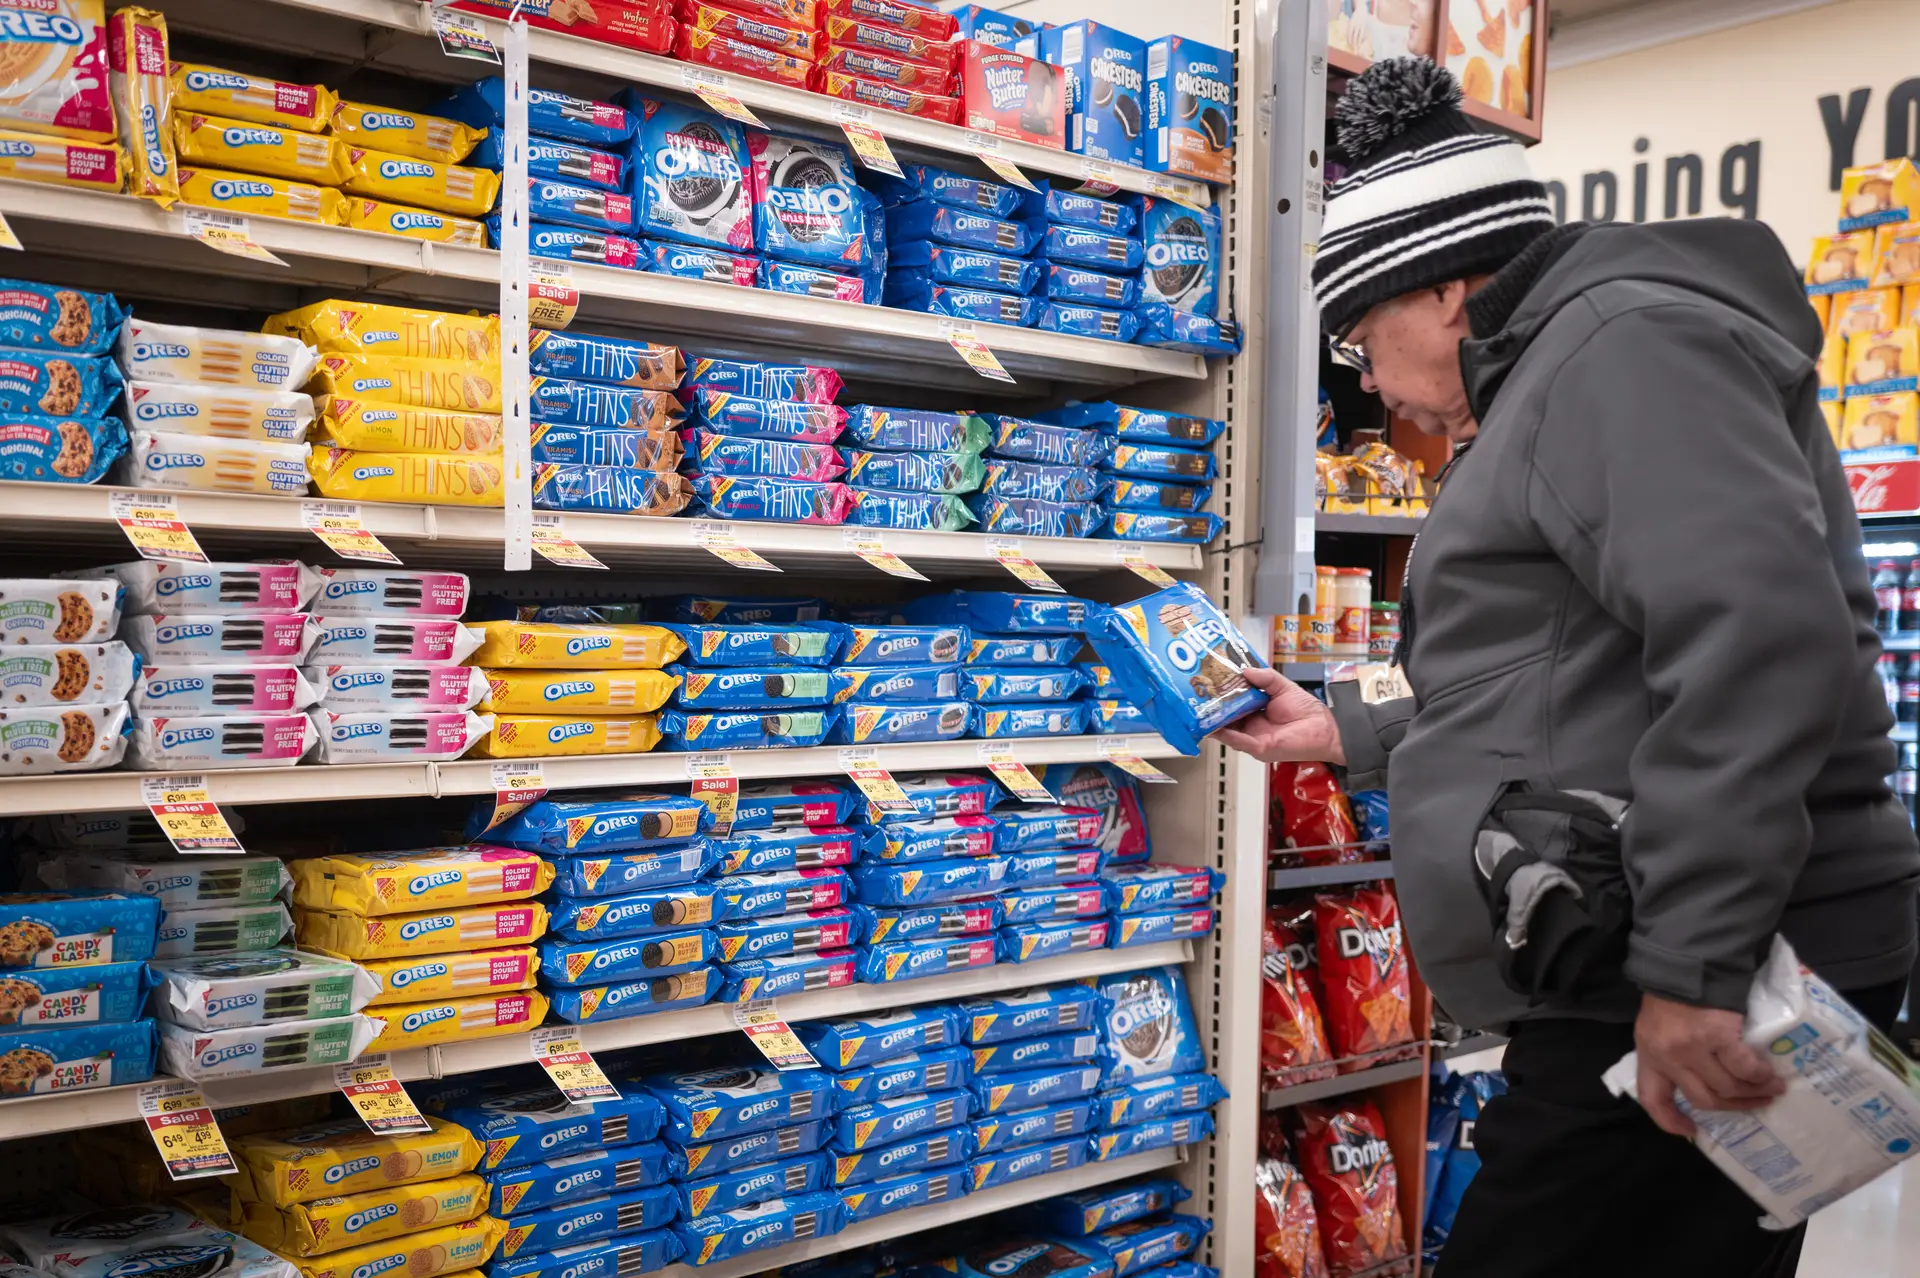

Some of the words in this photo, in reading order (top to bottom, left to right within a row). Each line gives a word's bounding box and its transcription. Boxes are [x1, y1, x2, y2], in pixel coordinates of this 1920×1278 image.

[0, 10, 82, 42] REO
[623, 10, 649, 25] Wafers
[735, 18, 760, 34] Nutter
[761, 24, 787, 41] Butter
[856, 24, 881, 40] Nutter
[882, 30, 910, 48] Butter
[844, 51, 869, 67] Nutter
[870, 57, 900, 76] Butter
[981, 54, 998, 64] FUDGE
[999, 54, 1024, 64] COVERED
[1090, 58, 1142, 93] CAKESTERS
[1188, 62, 1219, 75] OREO
[186, 71, 248, 91] OREO
[985, 67, 1024, 89] Nutter
[277, 86, 309, 98] GOLDEN
[855, 79, 880, 96] Nutter
[881, 86, 910, 104] Butter
[990, 83, 1028, 106] Butter
[1175, 73, 1230, 105] CAKESTERS
[277, 94, 309, 105] DOUBLE
[277, 101, 298, 110] STUF
[361, 111, 415, 131] OREO
[142, 104, 166, 177] OREO
[666, 132, 704, 151] DOUBLE
[705, 140, 729, 156] STUF
[70, 151, 106, 162] GOLDEN
[70, 160, 105, 170] DOUBLE
[70, 167, 92, 176] STUF
[380, 161, 434, 180] OREO
[211, 181, 274, 201] OREO
[390, 213, 443, 231] OREO
[535, 232, 584, 248] OREO
[1147, 243, 1209, 267] OREO
[538, 286, 569, 300] Sale!
[0, 309, 42, 326] ORIGINAL
[532, 307, 565, 320] FREE
[362, 332, 399, 345] OREO
[400, 321, 464, 361] THINS
[133, 344, 190, 363] OREO
[256, 352, 288, 363] GOLDEN
[545, 352, 577, 362] TIRAMISU
[581, 340, 636, 381] THINS
[252, 364, 289, 377] GLUTEN
[257, 373, 284, 384] FREE
[740, 365, 794, 401] THINS
[137, 403, 198, 420] OREO
[366, 426, 392, 434] LEMON
[545, 433, 577, 443] OREO
[909, 420, 952, 453] THINS
[1, 444, 44, 458] ORIGINAL
[545, 446, 577, 454] TIRAMISU
[579, 428, 636, 469] THINS
[1034, 431, 1072, 463] THINS
[146, 453, 205, 471] OREO
[271, 460, 304, 471] GOLDEN
[353, 466, 394, 480] OREO
[397, 456, 466, 496] THINS
[760, 485, 813, 519] THINS
[156, 575, 212, 597] OREO
[326, 581, 377, 599] OREO
[431, 590, 463, 599] GLUTEN
[276, 591, 293, 600] FREE
[28, 606, 50, 616] FREE!
[5, 618, 44, 630] ORIGINAL
[876, 636, 920, 656] OREO
[1165, 618, 1235, 673] OREO
[146, 678, 204, 700] OREO
[265, 685, 295, 693] GLUTEN
[332, 672, 384, 691] OREO
[718, 673, 762, 691] OREO
[492, 681, 509, 700] FAMILY
[544, 681, 595, 701] OREO
[3, 727, 31, 738] GLUTEN
[31, 726, 55, 737] FREE!
[162, 727, 214, 750] OREO
[442, 736, 460, 744] FREE
[500, 726, 518, 743] FAMILY
[506, 733, 519, 745] SIZE
[10, 738, 49, 749] ORIGINAL
[277, 741, 298, 749] FREE
[701, 780, 729, 790] Sale!
[507, 791, 538, 802] Sale!
[164, 804, 205, 814] Sale!
[806, 808, 829, 816] DOUBLE
[592, 815, 639, 836] OREO
[676, 815, 698, 823] PEANUT
[750, 846, 792, 867] OREO
[408, 870, 462, 896] OREO
[505, 873, 531, 881] DOUBLE
[251, 885, 271, 895] FREE
[400, 916, 455, 941] OREO
[498, 926, 514, 935] STUF
[898, 915, 936, 934] OREO
[56, 939, 102, 953] CANDY
[52, 948, 100, 964] BLASTS
[594, 946, 640, 969] OREO
[391, 962, 447, 988] OREO
[763, 971, 800, 993] OREO
[42, 994, 89, 1010] CANDY
[320, 1002, 342, 1011] FREE
[498, 1000, 525, 1008] GOLDEN
[498, 1006, 525, 1015] DOUBLE
[38, 1004, 86, 1020] BLASTS
[402, 1006, 455, 1032] OREO
[1110, 997, 1173, 1035] OREO
[751, 1023, 780, 1034] Sale!
[314, 1040, 348, 1051] GLUTEN
[881, 1027, 915, 1050] OREO
[201, 1042, 257, 1067] OREO
[549, 1053, 581, 1064] Sale!
[55, 1063, 101, 1079] CANDY
[51, 1072, 99, 1089] BLASTS
[354, 1082, 390, 1094] Sale!
[160, 1111, 200, 1126] Sale!
[738, 1099, 779, 1121] OREO
[1012, 1117, 1047, 1137] OREO
[540, 1124, 588, 1150] OREO
[426, 1150, 459, 1164] LEMON
[489, 1140, 508, 1163] FAMILY
[879, 1144, 916, 1166] OREO
[323, 1156, 380, 1185] OREO
[290, 1169, 310, 1190] FAMILY
[554, 1169, 602, 1196] OREO
[344, 1203, 398, 1232] OREO
[742, 1220, 783, 1245] OREO
[450, 1241, 482, 1257] LEMON
